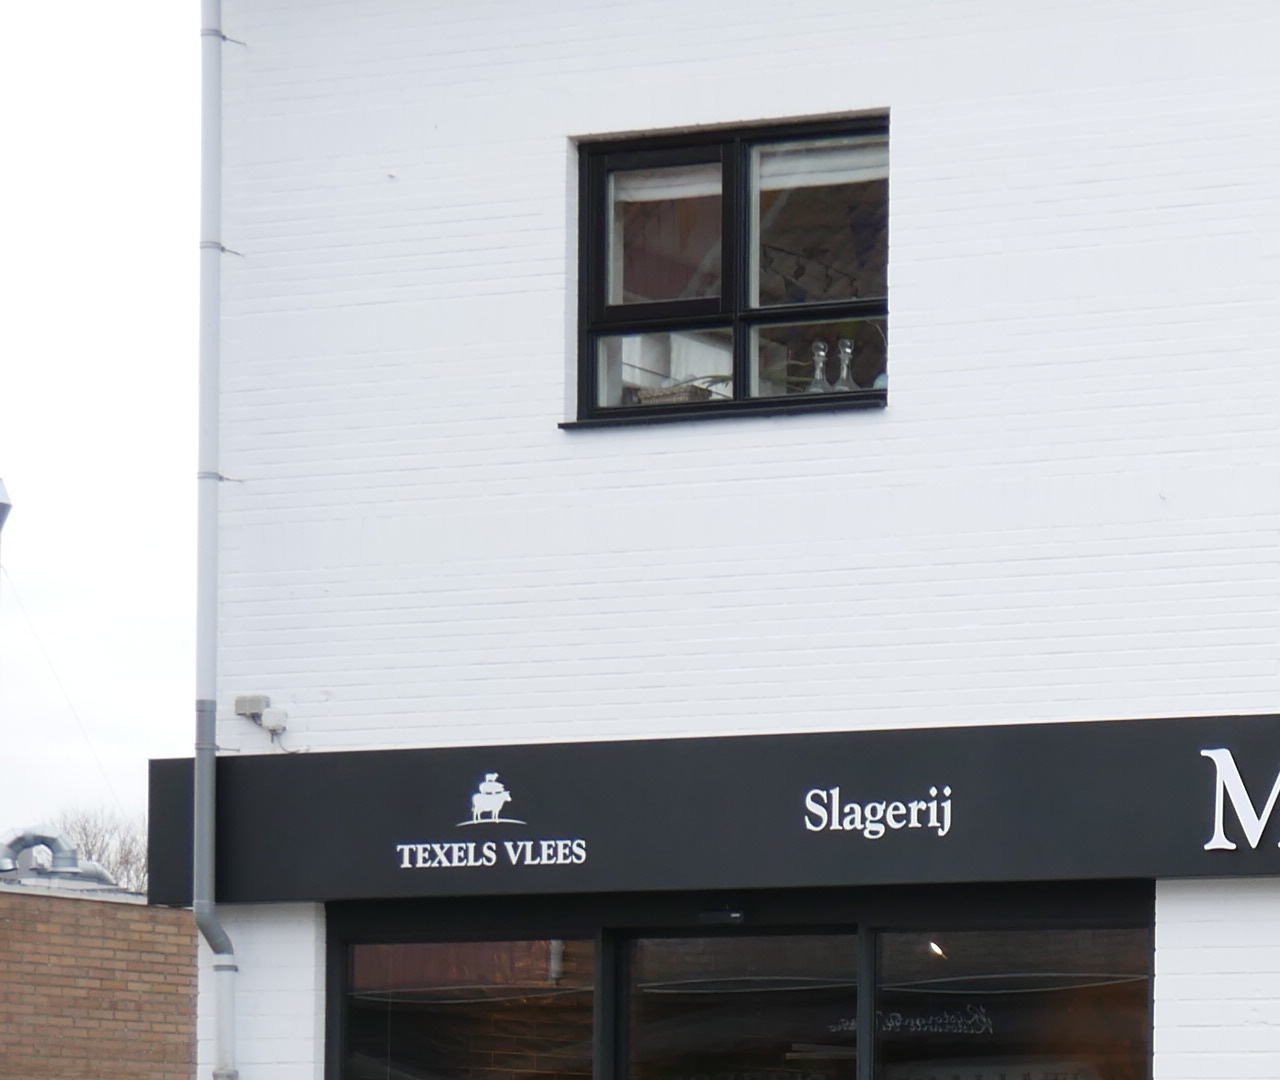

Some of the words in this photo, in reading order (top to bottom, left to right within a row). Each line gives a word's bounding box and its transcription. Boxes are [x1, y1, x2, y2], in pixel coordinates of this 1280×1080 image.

[804, 785, 952, 840] Slagerij
[396, 841, 497, 869] TEXELS
[503, 839, 587, 866] VLEES
